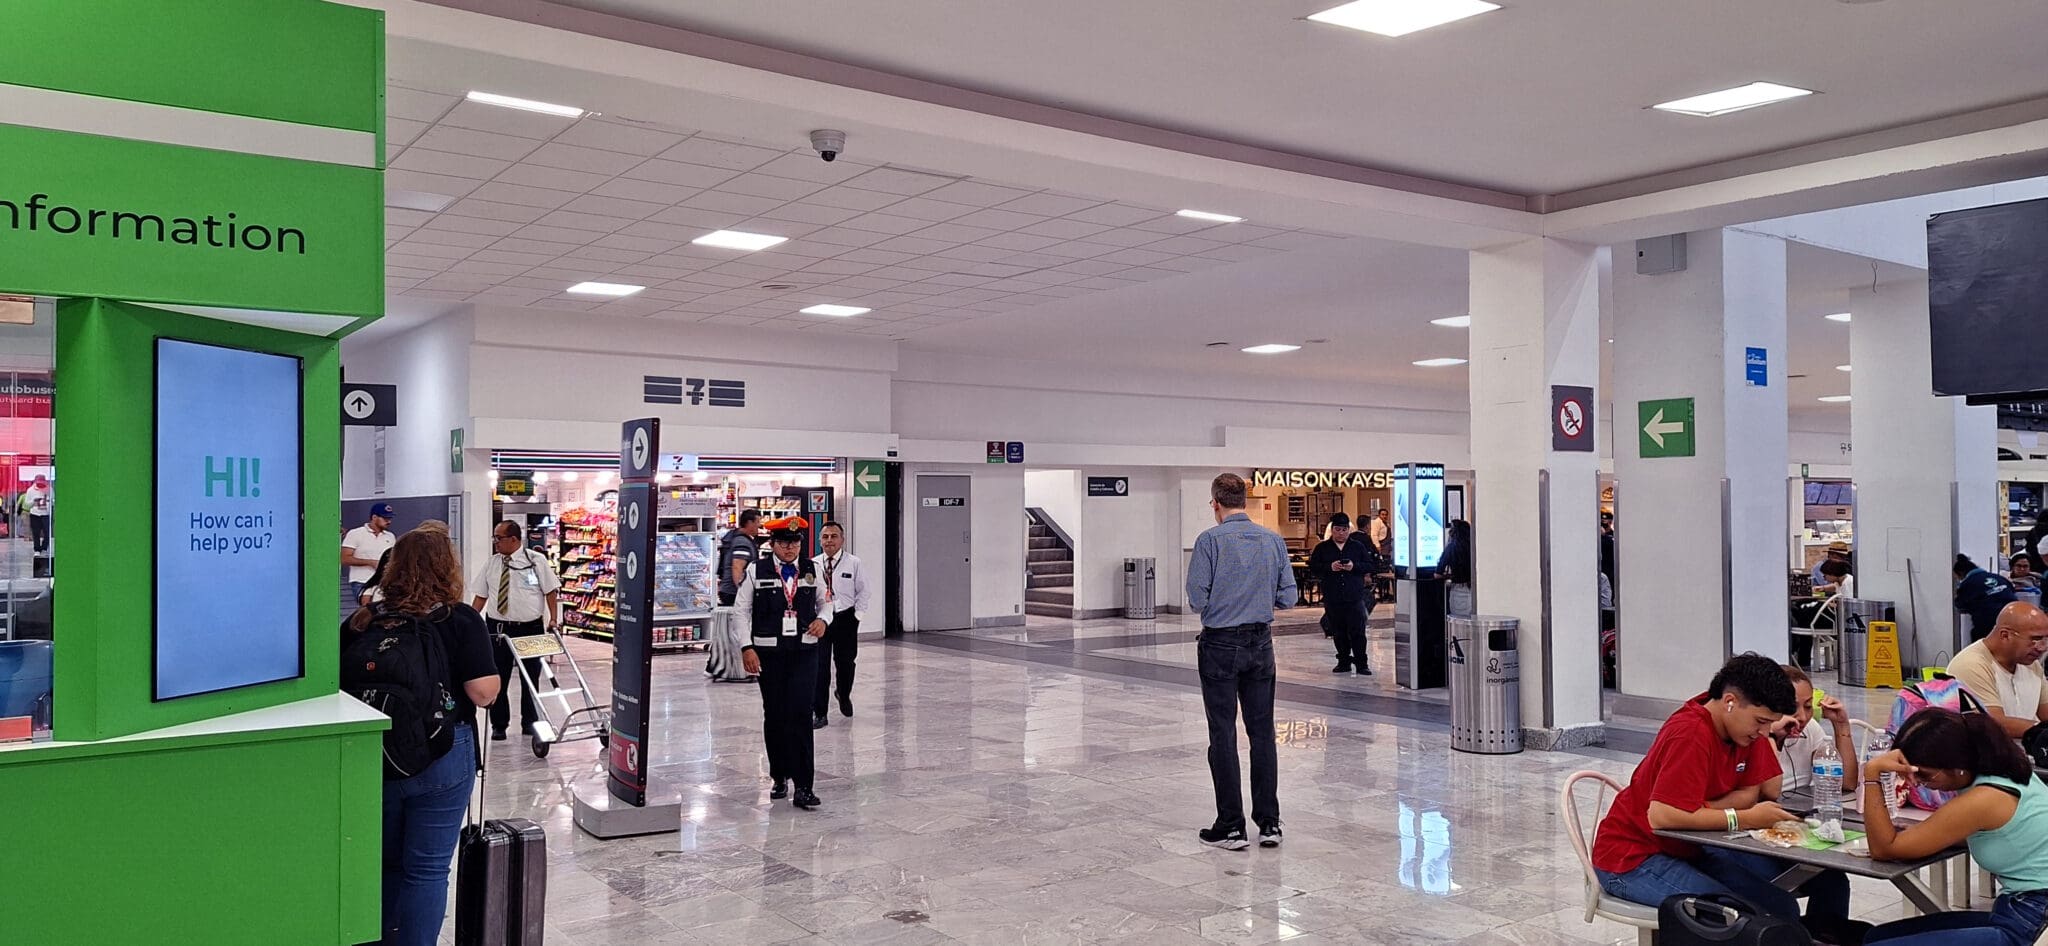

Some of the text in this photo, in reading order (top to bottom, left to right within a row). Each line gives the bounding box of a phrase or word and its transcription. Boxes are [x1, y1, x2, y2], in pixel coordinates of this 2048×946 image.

[205, 455, 261, 498] HI!
[1254, 471, 1332, 488] MAISON
[1416, 467, 1443, 477] HONOR
[190, 510, 273, 529] How can i
[190, 532, 273, 555] help you?
